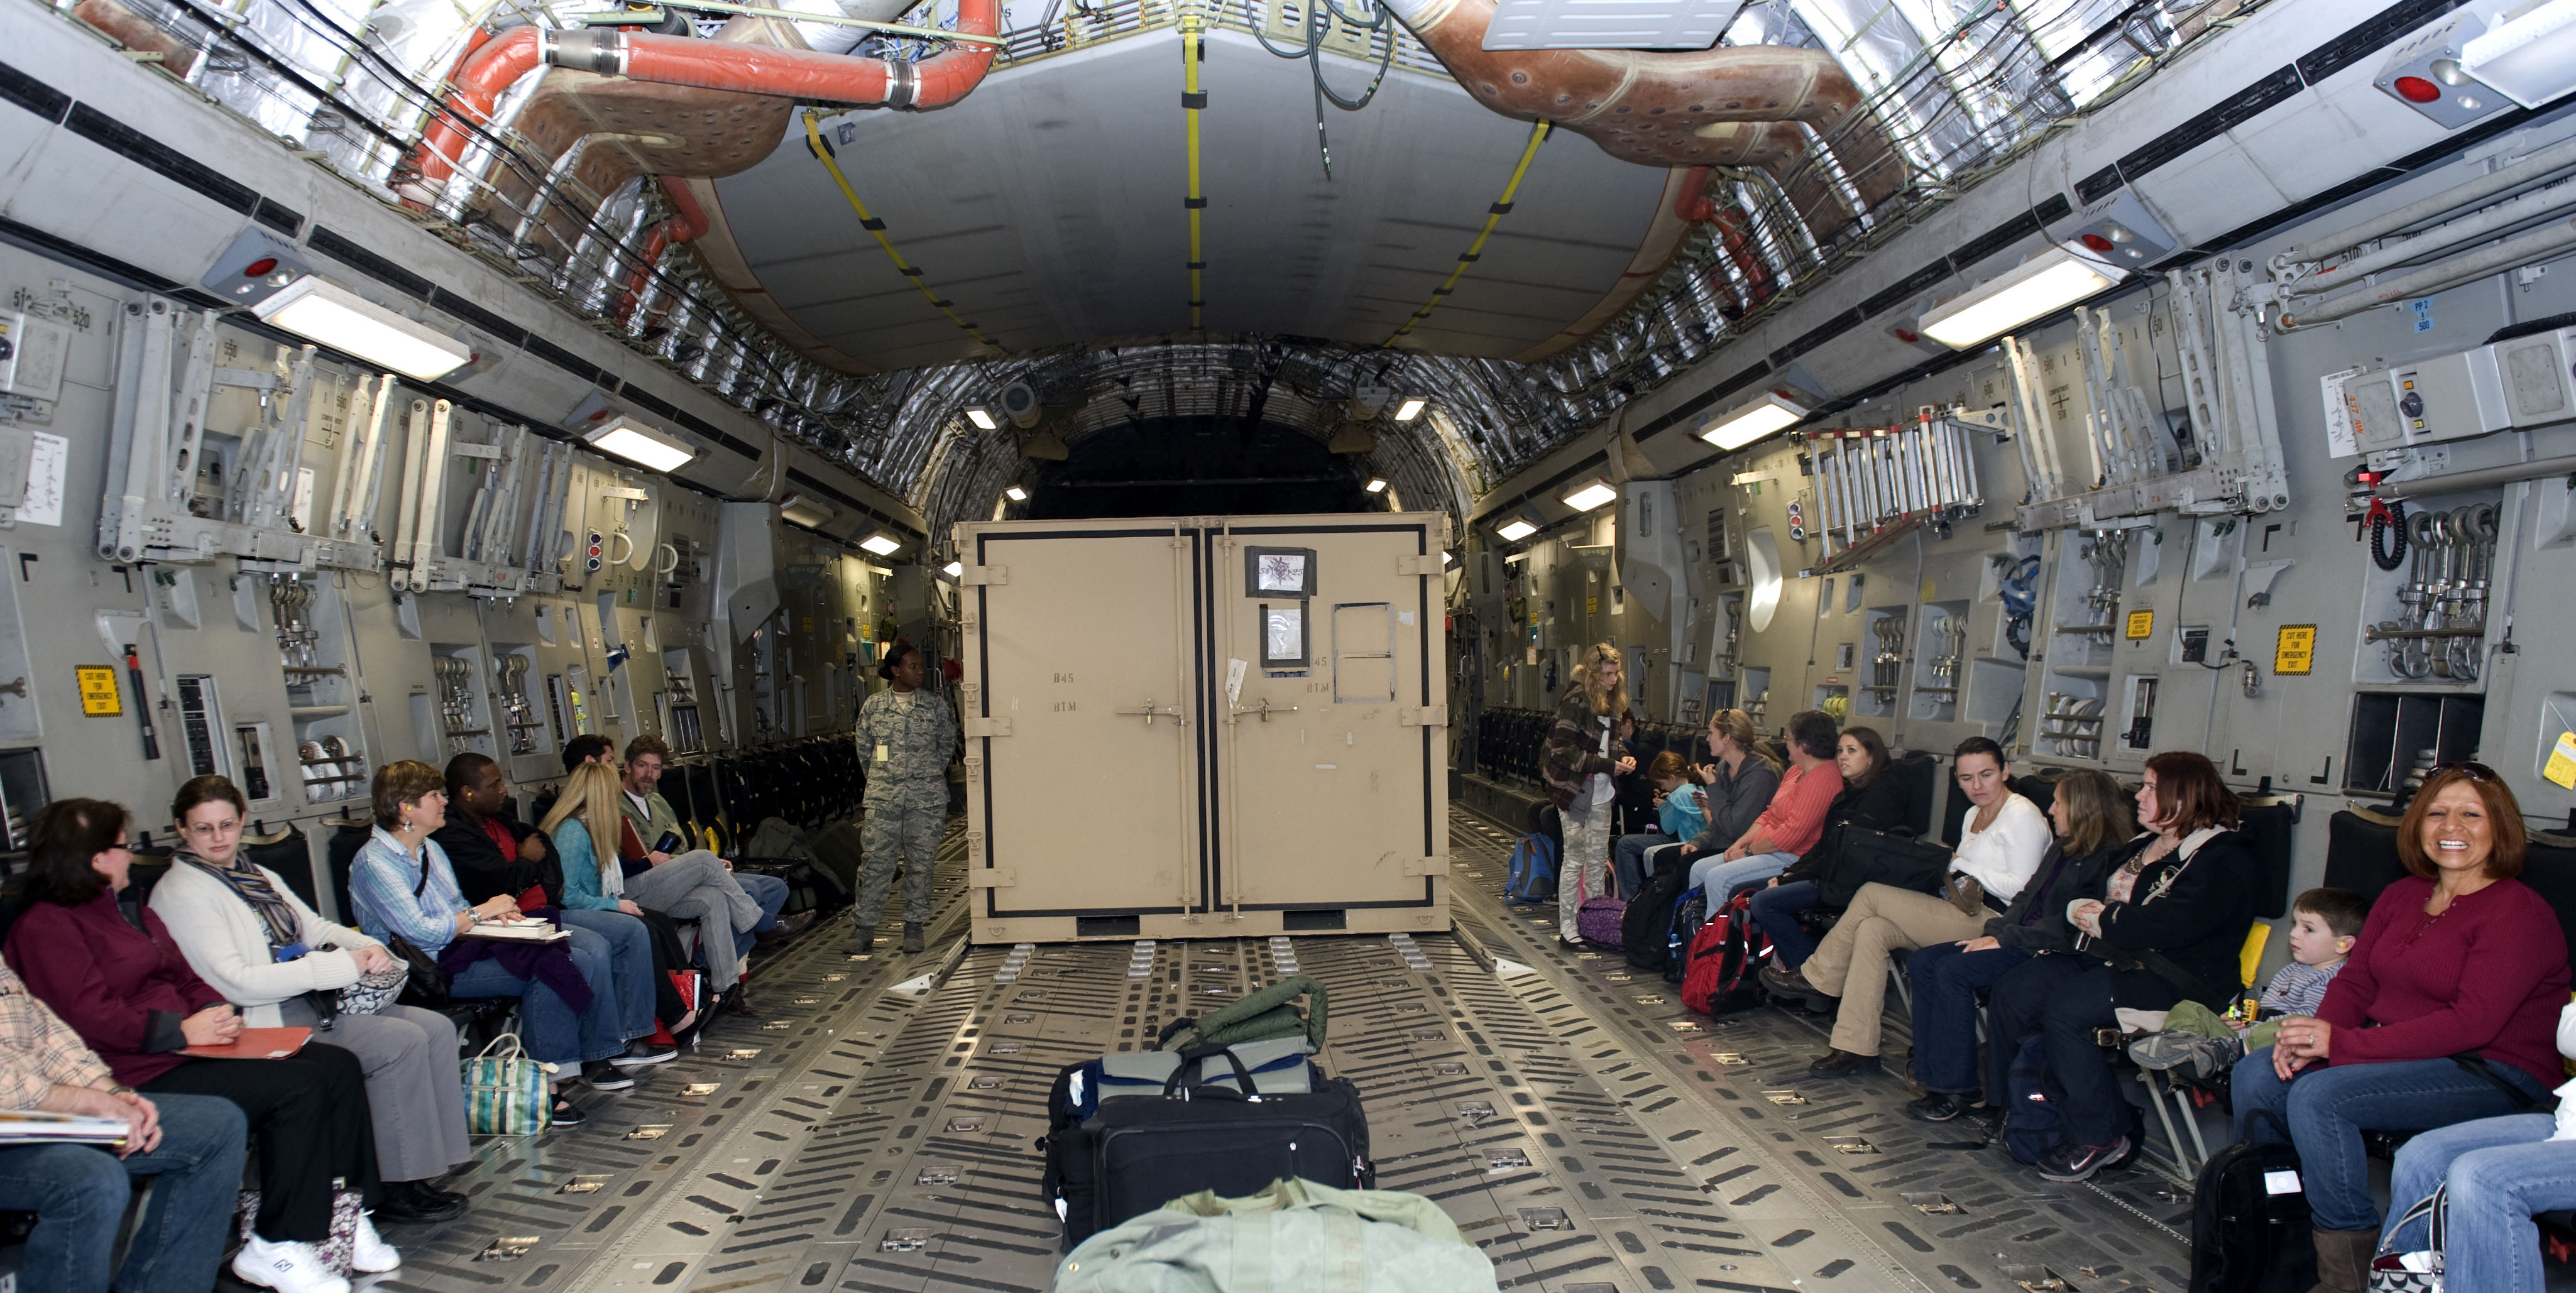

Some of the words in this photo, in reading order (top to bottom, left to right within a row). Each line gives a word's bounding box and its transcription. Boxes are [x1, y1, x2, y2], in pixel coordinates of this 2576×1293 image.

[2415, 302, 2422, 311] PP
[2425, 300, 2428, 308] 2
[73, 310, 89, 328] 520
[2419, 321, 2429, 331] 500
[224, 342, 237, 358] 550
[2349, 395, 2360, 415] 437
[2354, 418, 2364, 434] AW
[2281, 651, 2308, 659] EMERGENCY
[2288, 660, 2298, 668] EXIT
[1054, 673, 1073, 684] B45
[1307, 683, 1329, 694] BTM
[1054, 701, 1076, 712] BTM
